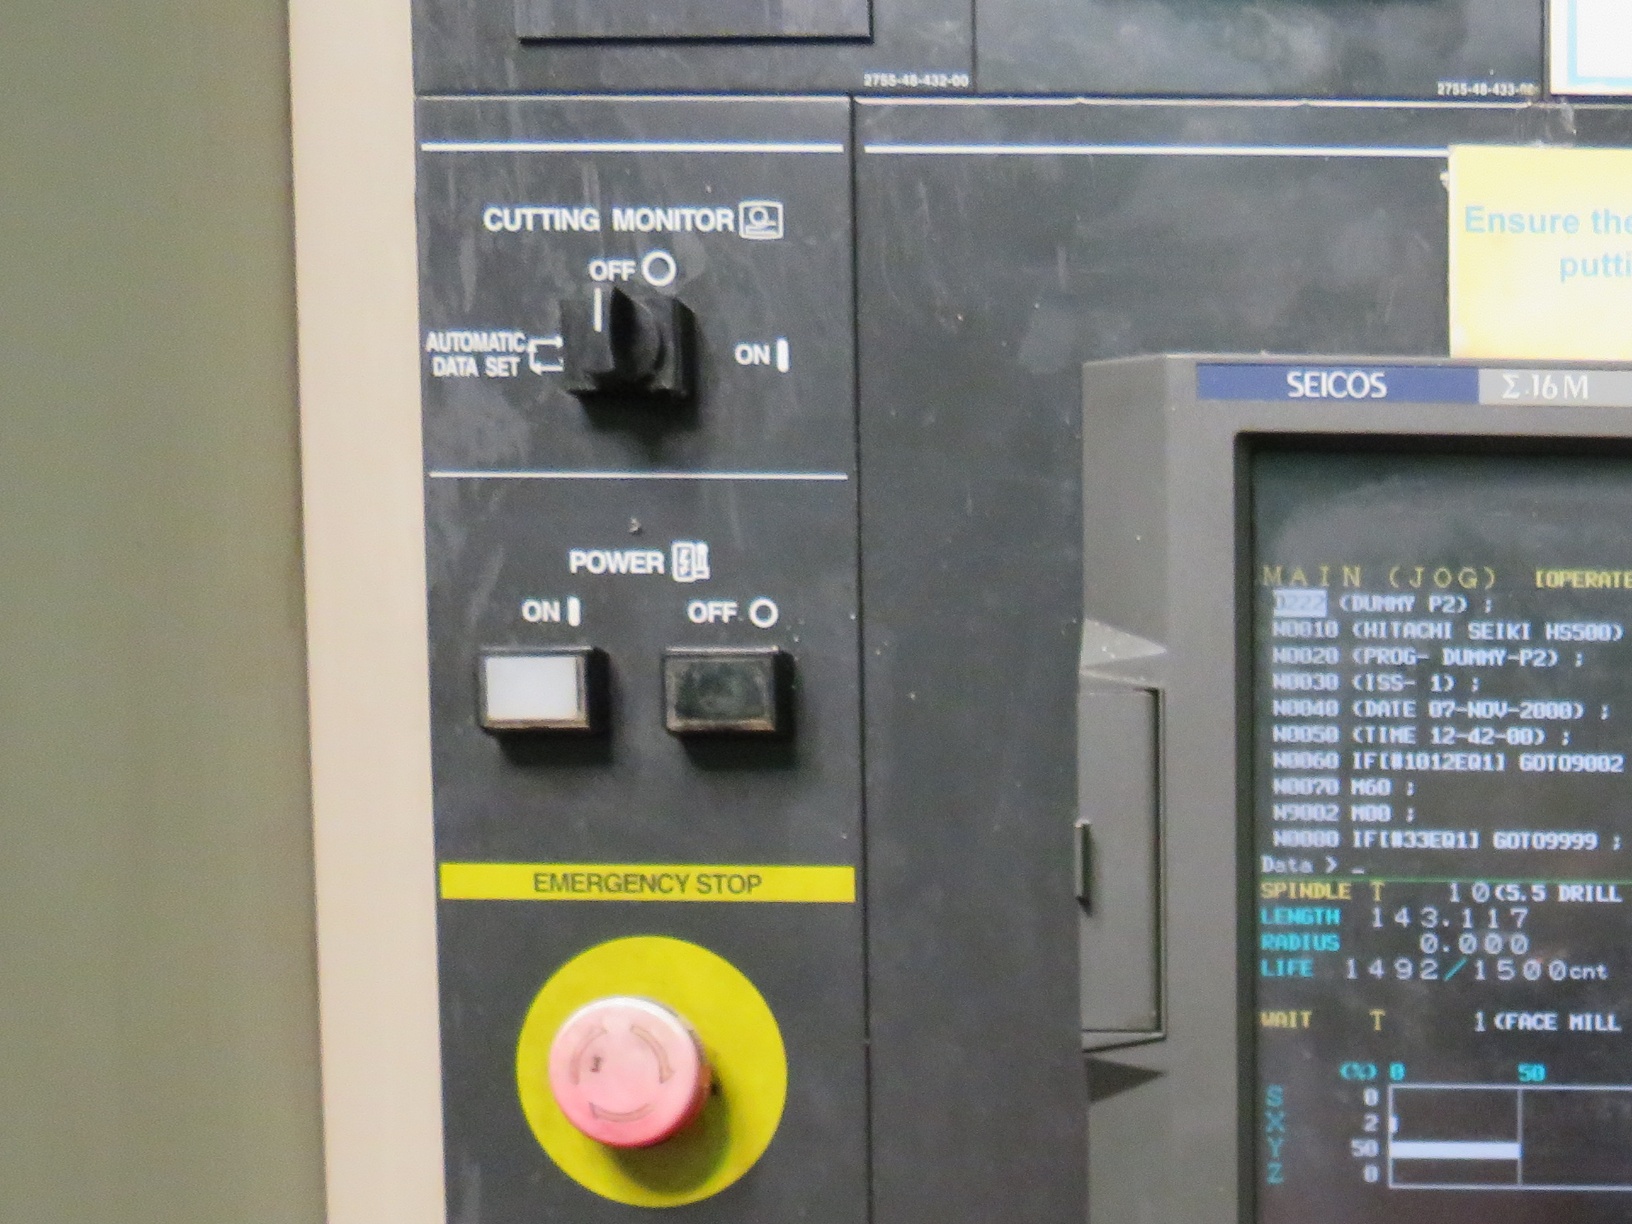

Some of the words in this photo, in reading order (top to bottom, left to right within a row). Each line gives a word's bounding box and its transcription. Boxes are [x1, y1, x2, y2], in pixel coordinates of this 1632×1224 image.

[484, 205, 600, 231] CUTTING
[613, 207, 734, 231] MONITOR
[1465, 205, 1580, 234] Ensure
[589, 258, 635, 281] OFF
[426, 331, 529, 353] AUTOMATIC
[735, 343, 770, 364] ON
[433, 355, 478, 376] DATA
[485, 354, 520, 377] SET
[1287, 370, 1387, 398] SEICOS
[569, 549, 664, 573] POWER
[1265, 566, 1360, 591] MAIN
[1386, 565, 1495, 592] (JOG)
[522, 600, 560, 622] ON
[687, 601, 737, 623] OFF
[1468, 622, 1530, 639] SEIKI
[1262, 855, 1313, 873] Data
[532, 871, 690, 896] EMERGENCY
[694, 872, 763, 897] STOP
[1260, 882, 1351, 900] SPINDLE
[1558, 884, 1622, 902] DRILL
[1262, 908, 1340, 924] LENGTH
[1373, 906, 1529, 929] 143.117
[1262, 933, 1340, 951] RADIUS
[1420, 931, 1529, 955] 0.000
[1262, 958, 1312, 976] LIFE
[1261, 1011, 1311, 1028] WAIT
[1570, 1013, 1621, 1031] MILL
